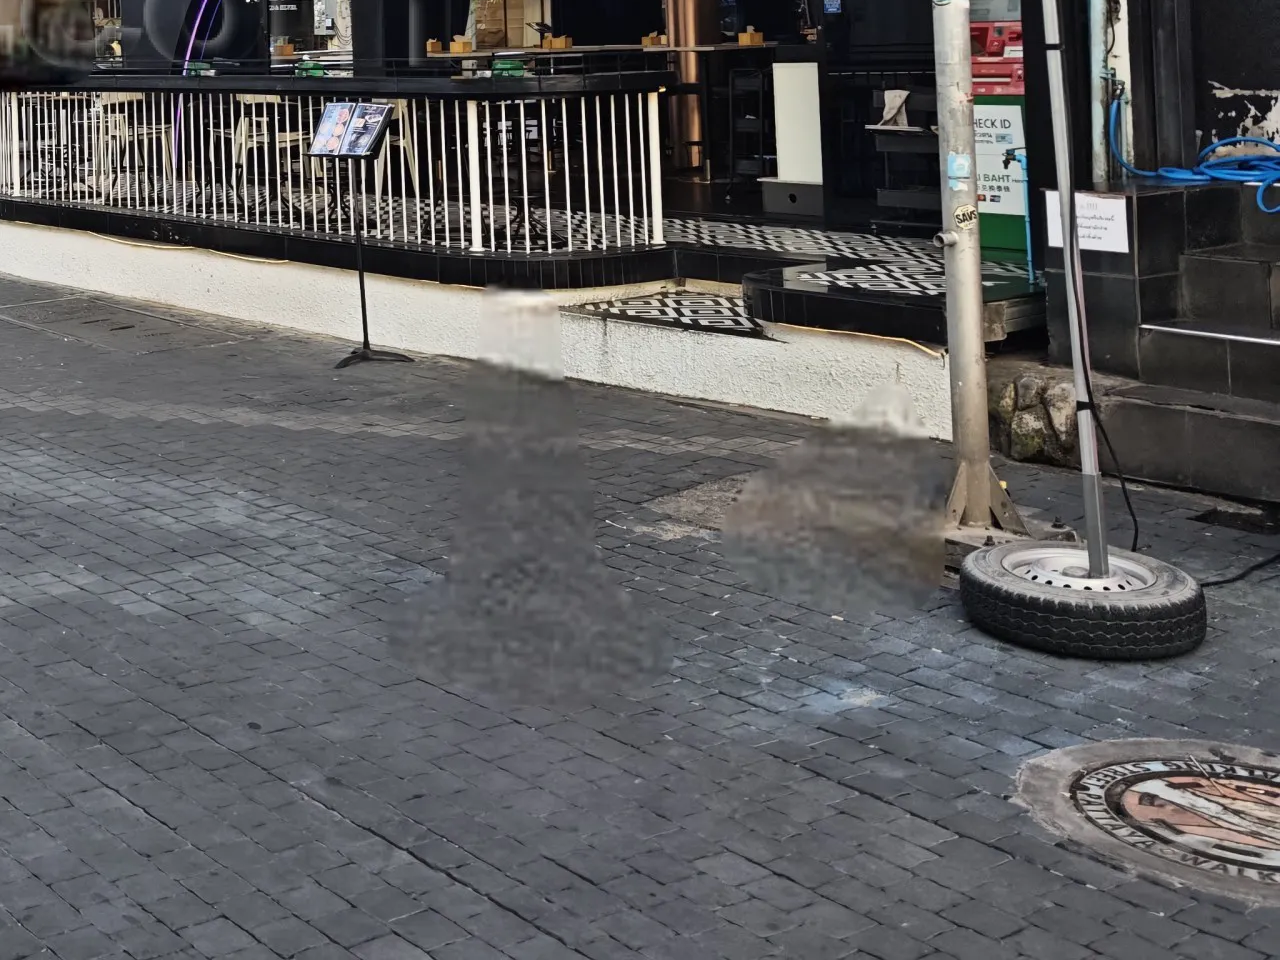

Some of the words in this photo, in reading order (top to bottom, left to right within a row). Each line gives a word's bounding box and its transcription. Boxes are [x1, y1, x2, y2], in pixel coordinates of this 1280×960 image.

[973, 118, 997, 129] HECK
[1000, 119, 1012, 129] ID
[983, 173, 1011, 182] BAHT
[1076, 791, 1157, 850] PATTAYA
